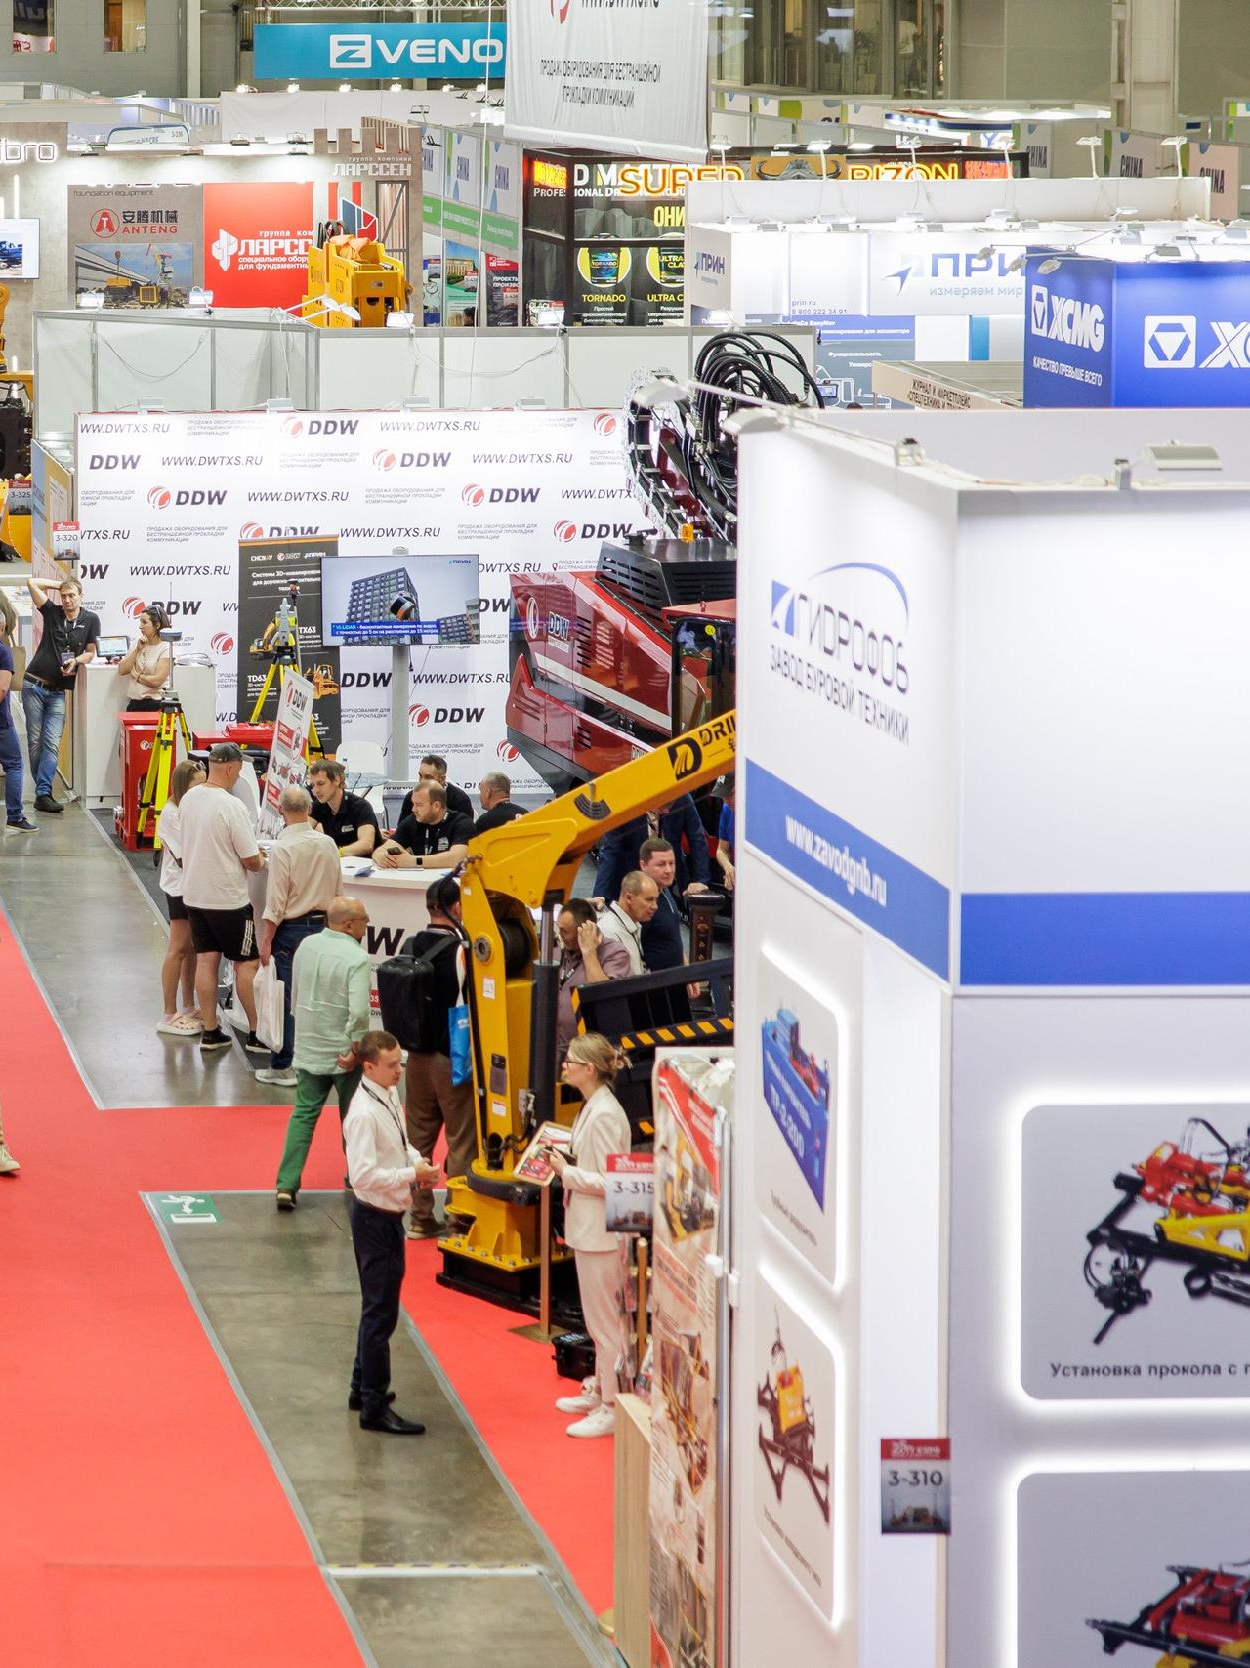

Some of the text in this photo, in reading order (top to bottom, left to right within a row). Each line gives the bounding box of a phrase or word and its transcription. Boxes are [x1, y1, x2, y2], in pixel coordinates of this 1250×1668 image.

[333, 163, 412, 177] ЛАРССЕН
[122, 226, 178, 234] ANTENG
[700, 252, 726, 276] ПРИН
[582, 294, 627, 303] TORNADO
[647, 294, 676, 302] ULTRA
[997, 287, 1024, 298] мир
[1047, 295, 1105, 352] XCMG
[1032, 355, 1059, 375] КАЧЕСТВО
[1085, 370, 1103, 387] ВСЕГО
[308, 420, 360, 436] DDW
[380, 420, 482, 433] WWW.DWTXS.RU
[89, 454, 142, 470] DDW
[161, 455, 264, 467] WWW.DWTXS.RU
[400, 452, 452, 468] DDW
[472, 453, 573, 465] WWW.DWTXS.RU
[175, 490, 228, 506] DDW
[247, 491, 350, 503] WWW.DWTXS.RU
[488, 487, 541, 503] DDW
[55, 533, 78, 542] 3-320
[340, 527, 441, 539] WWW.DWTXS.RU
[581, 523, 633, 540] DDW
[129, 565, 231, 577] WWW.DWTXS.RU
[298, 626, 316, 634] TX63
[796, 591, 909, 696] ГИДРОФОБ
[341, 672, 393, 688] DDW
[770, 643, 910, 748] ЗАВОД БУРОВОЙ ТЕХНИКИ
[434, 707, 486, 723] DDW
[784, 813, 887, 908] www.zavodgnb.ru
[1049, 1362, 1142, 1378] Установка
[1148, 1364, 1222, 1381] прокола
[888, 1469, 943, 1487] 3-310
